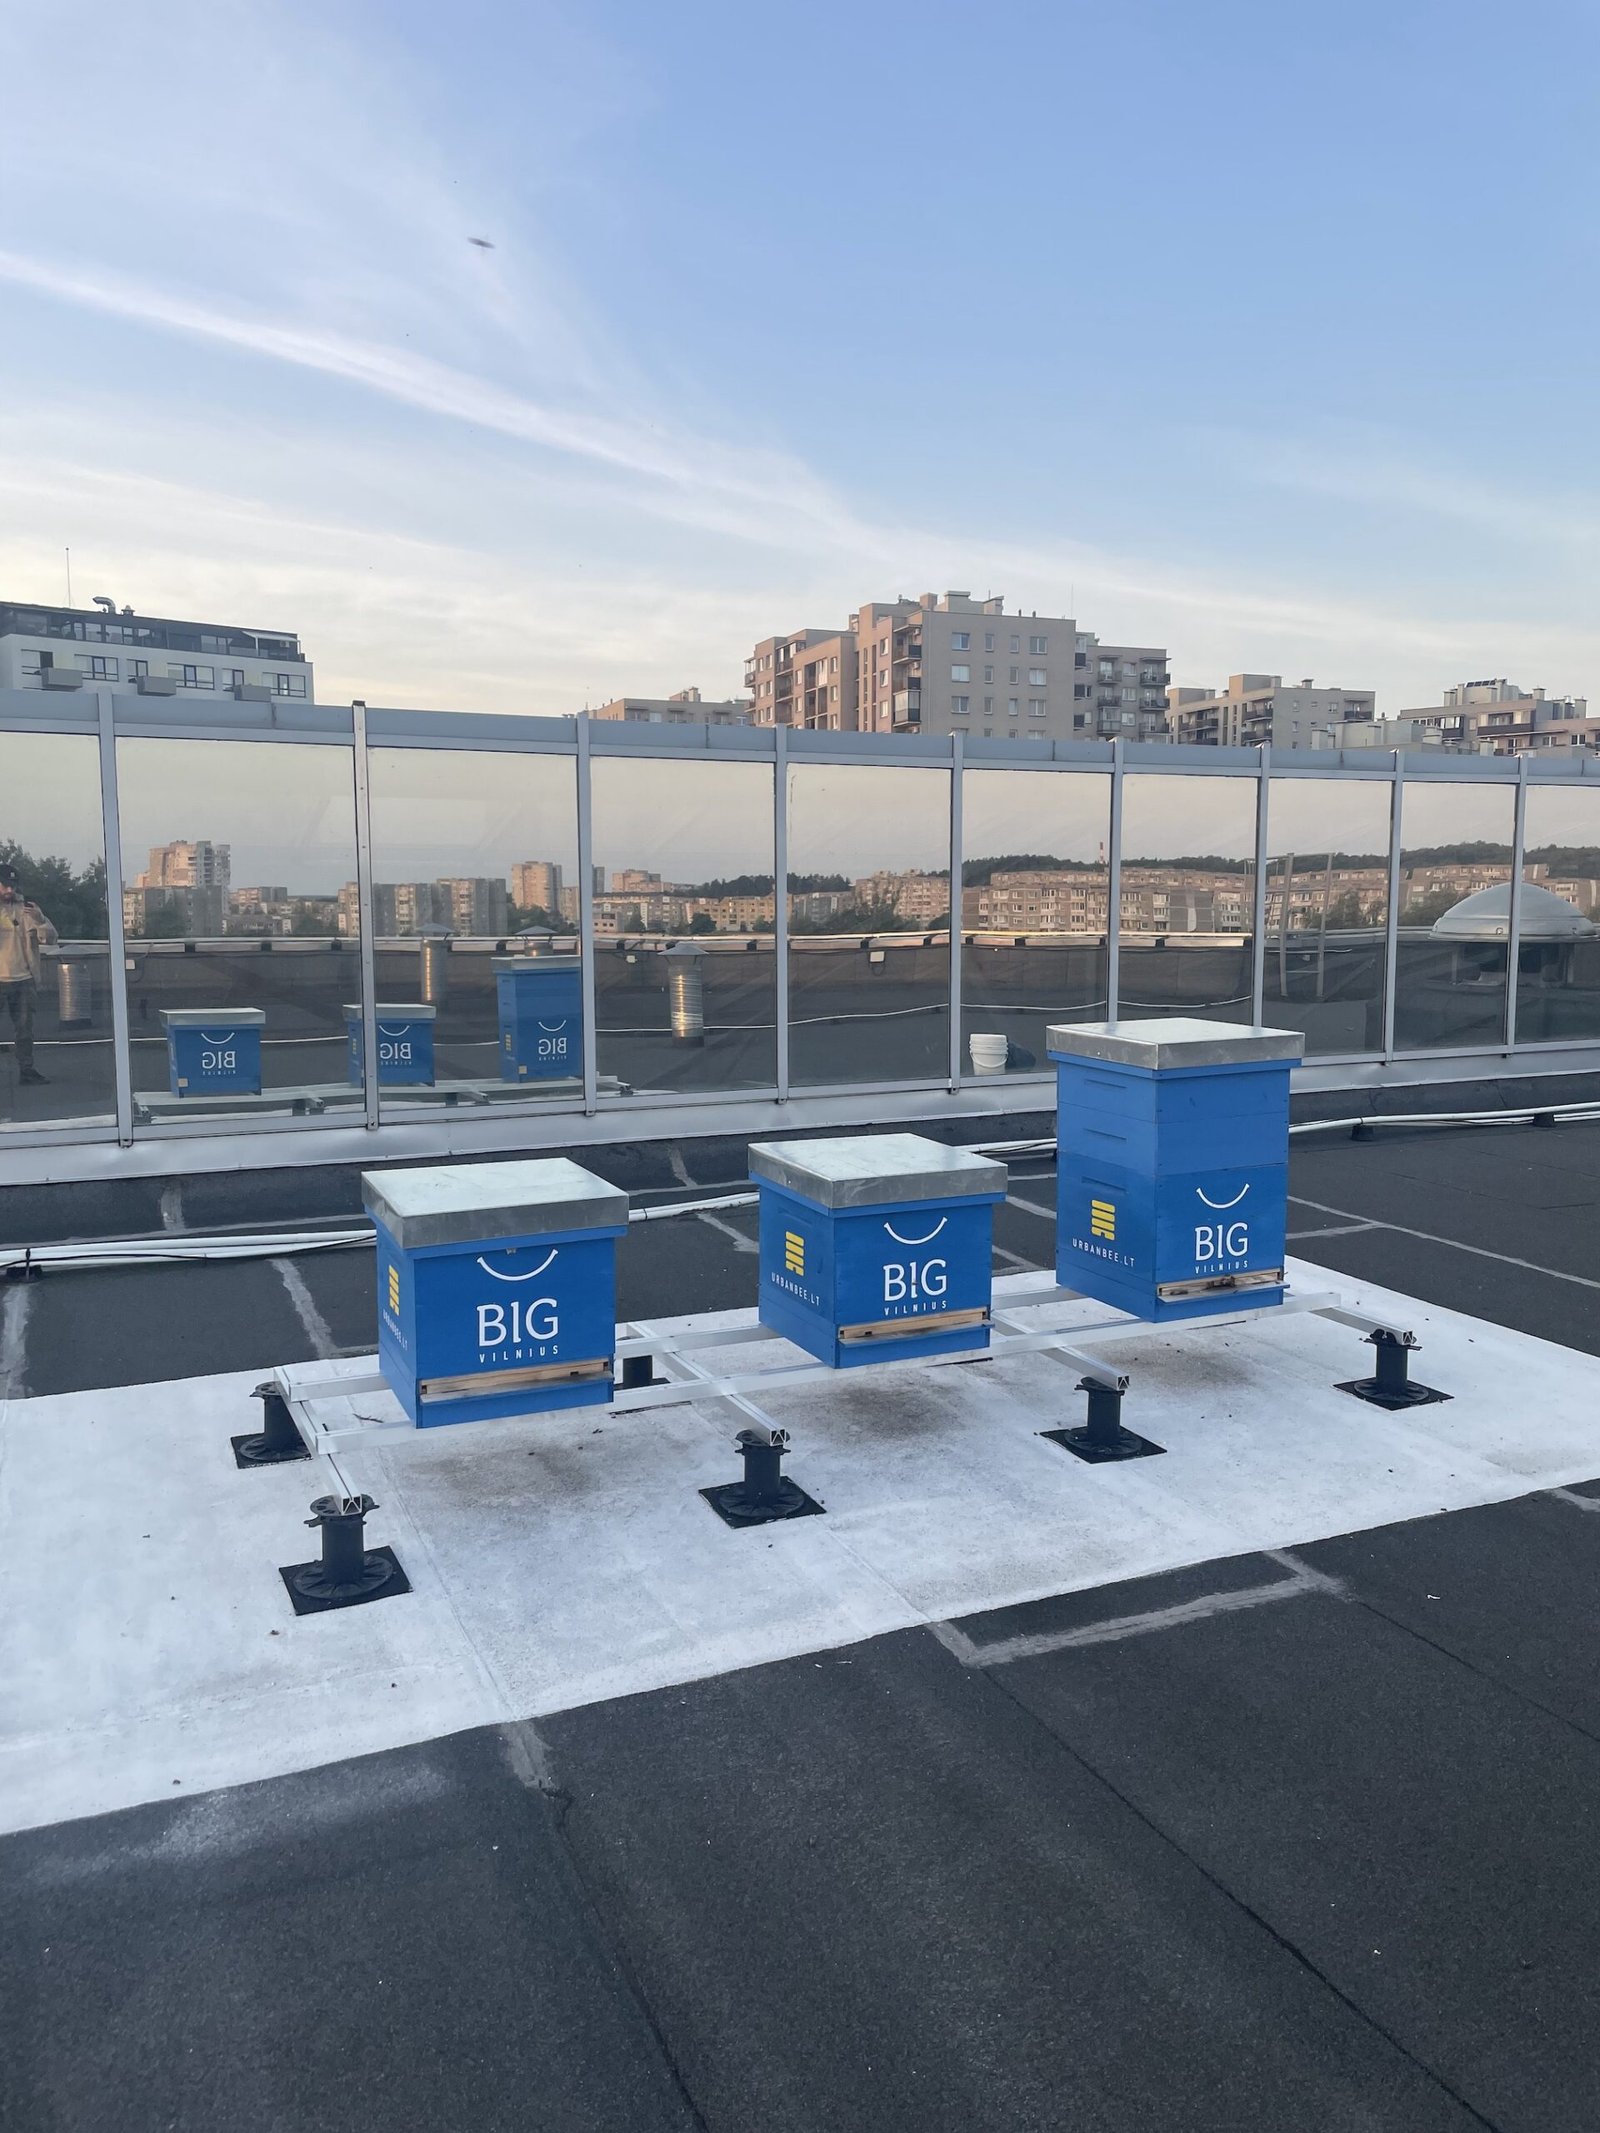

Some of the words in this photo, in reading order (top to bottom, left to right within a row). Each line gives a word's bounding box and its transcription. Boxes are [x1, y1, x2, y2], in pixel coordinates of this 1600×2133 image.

[1072, 1237, 1135, 1268] URBANBEE.LT
[1194, 1222, 1248, 1261] BIG
[882, 1258, 947, 1302] BIG
[1195, 1260, 1248, 1274] VILNIUS
[771, 1272, 820, 1307] URBANBEE.LT
[476, 1298, 559, 1347] BIG
[884, 1300, 947, 1316] VILNIUS
[479, 1345, 559, 1363] VILNIUS
